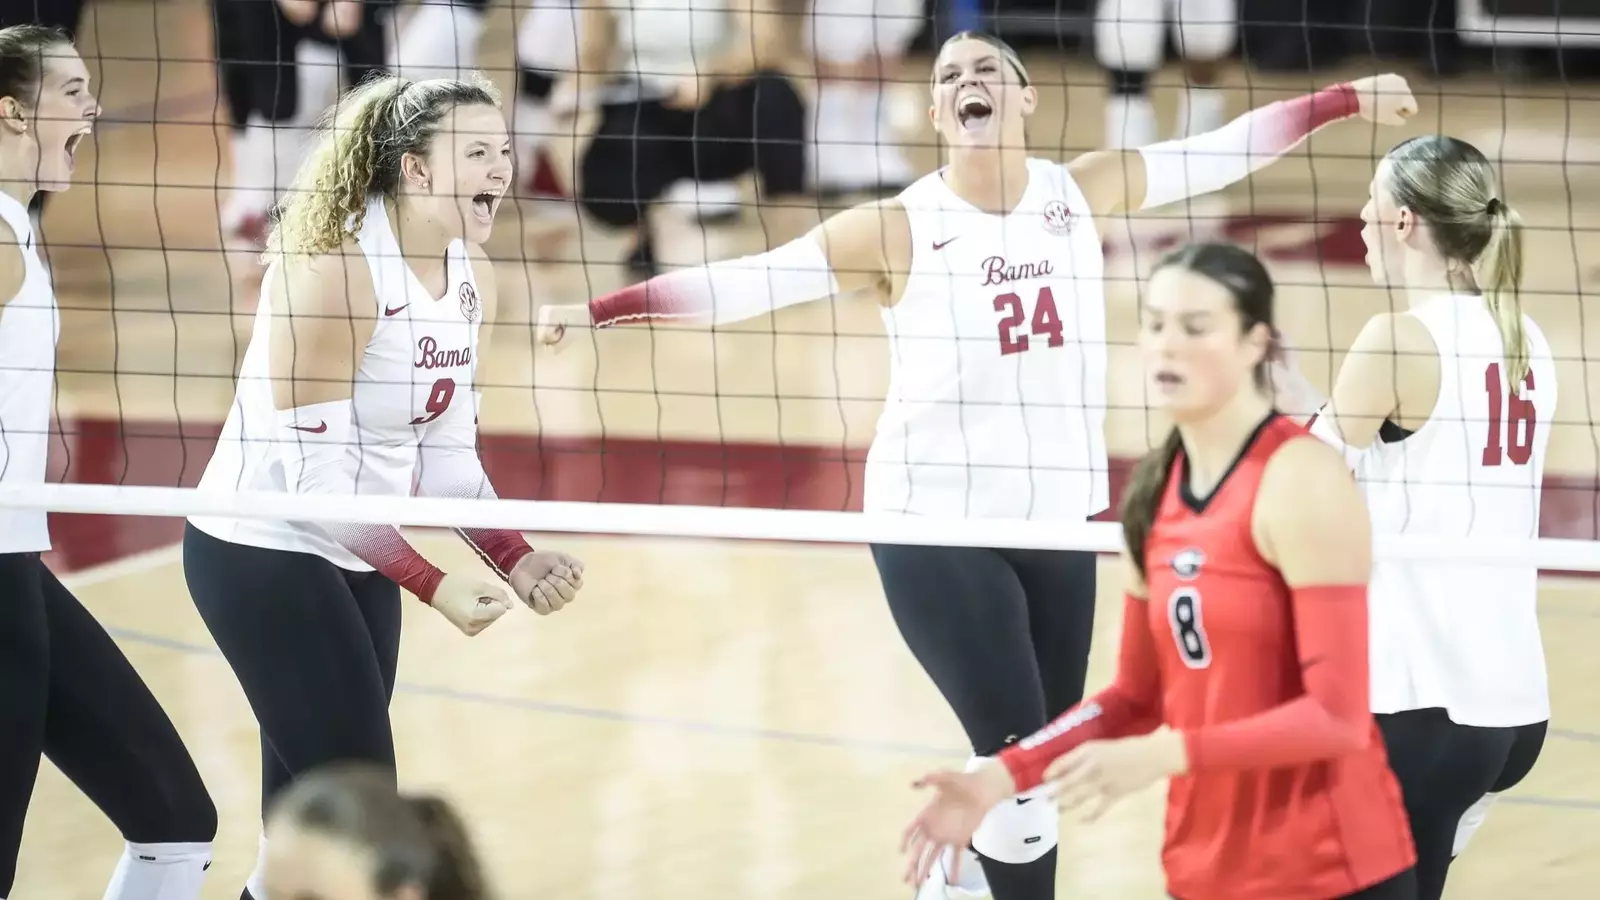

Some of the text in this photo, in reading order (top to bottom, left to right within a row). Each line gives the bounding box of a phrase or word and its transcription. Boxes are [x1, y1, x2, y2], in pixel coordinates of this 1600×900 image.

[980, 255, 1054, 287] Bama
[992, 286, 1064, 356] 24
[414, 336, 471, 370] Bama
[408, 377, 456, 425] 9
[1482, 362, 1536, 466] 16
[1170, 589, 1209, 667] 8
